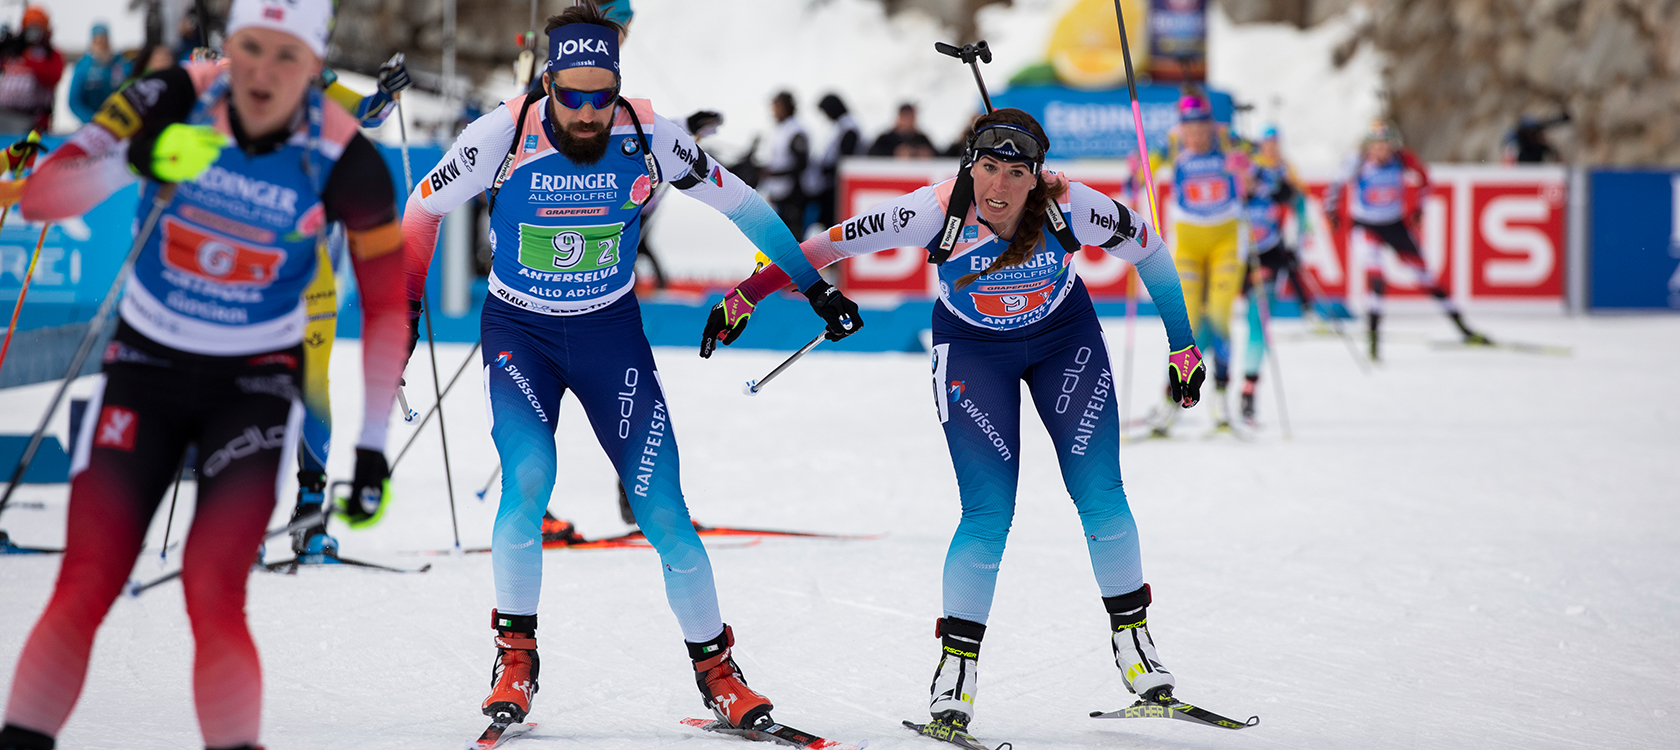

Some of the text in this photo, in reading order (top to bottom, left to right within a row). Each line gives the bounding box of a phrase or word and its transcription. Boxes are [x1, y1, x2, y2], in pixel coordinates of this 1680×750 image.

[556, 38, 609, 61] JOKA
[431, 158, 461, 192] BKW
[530, 172, 619, 192] ERDINGER
[528, 191, 617, 202] ALKOHOLFREI
[545, 208, 601, 216] GRAPEFRUIT
[845, 212, 886, 241] BKW
[552, 230, 616, 269] 9 2
[518, 265, 619, 283] ANTERSELVA
[976, 266, 1058, 281] LKOHOLFREI
[986, 281, 1043, 291] GRAPEFRUIT
[1000, 294, 1028, 313] 9
[1055, 346, 1092, 414] odlo
[504, 364, 548, 422] swisscom
[618, 367, 638, 439] odlo
[1070, 368, 1112, 456] RAIFFEISEN
[960, 398, 1012, 461] swisscom
[634, 399, 666, 497] RAIFFEISEN
[943, 645, 977, 658] FISCHER
[1124, 704, 1164, 719] FISCHER
